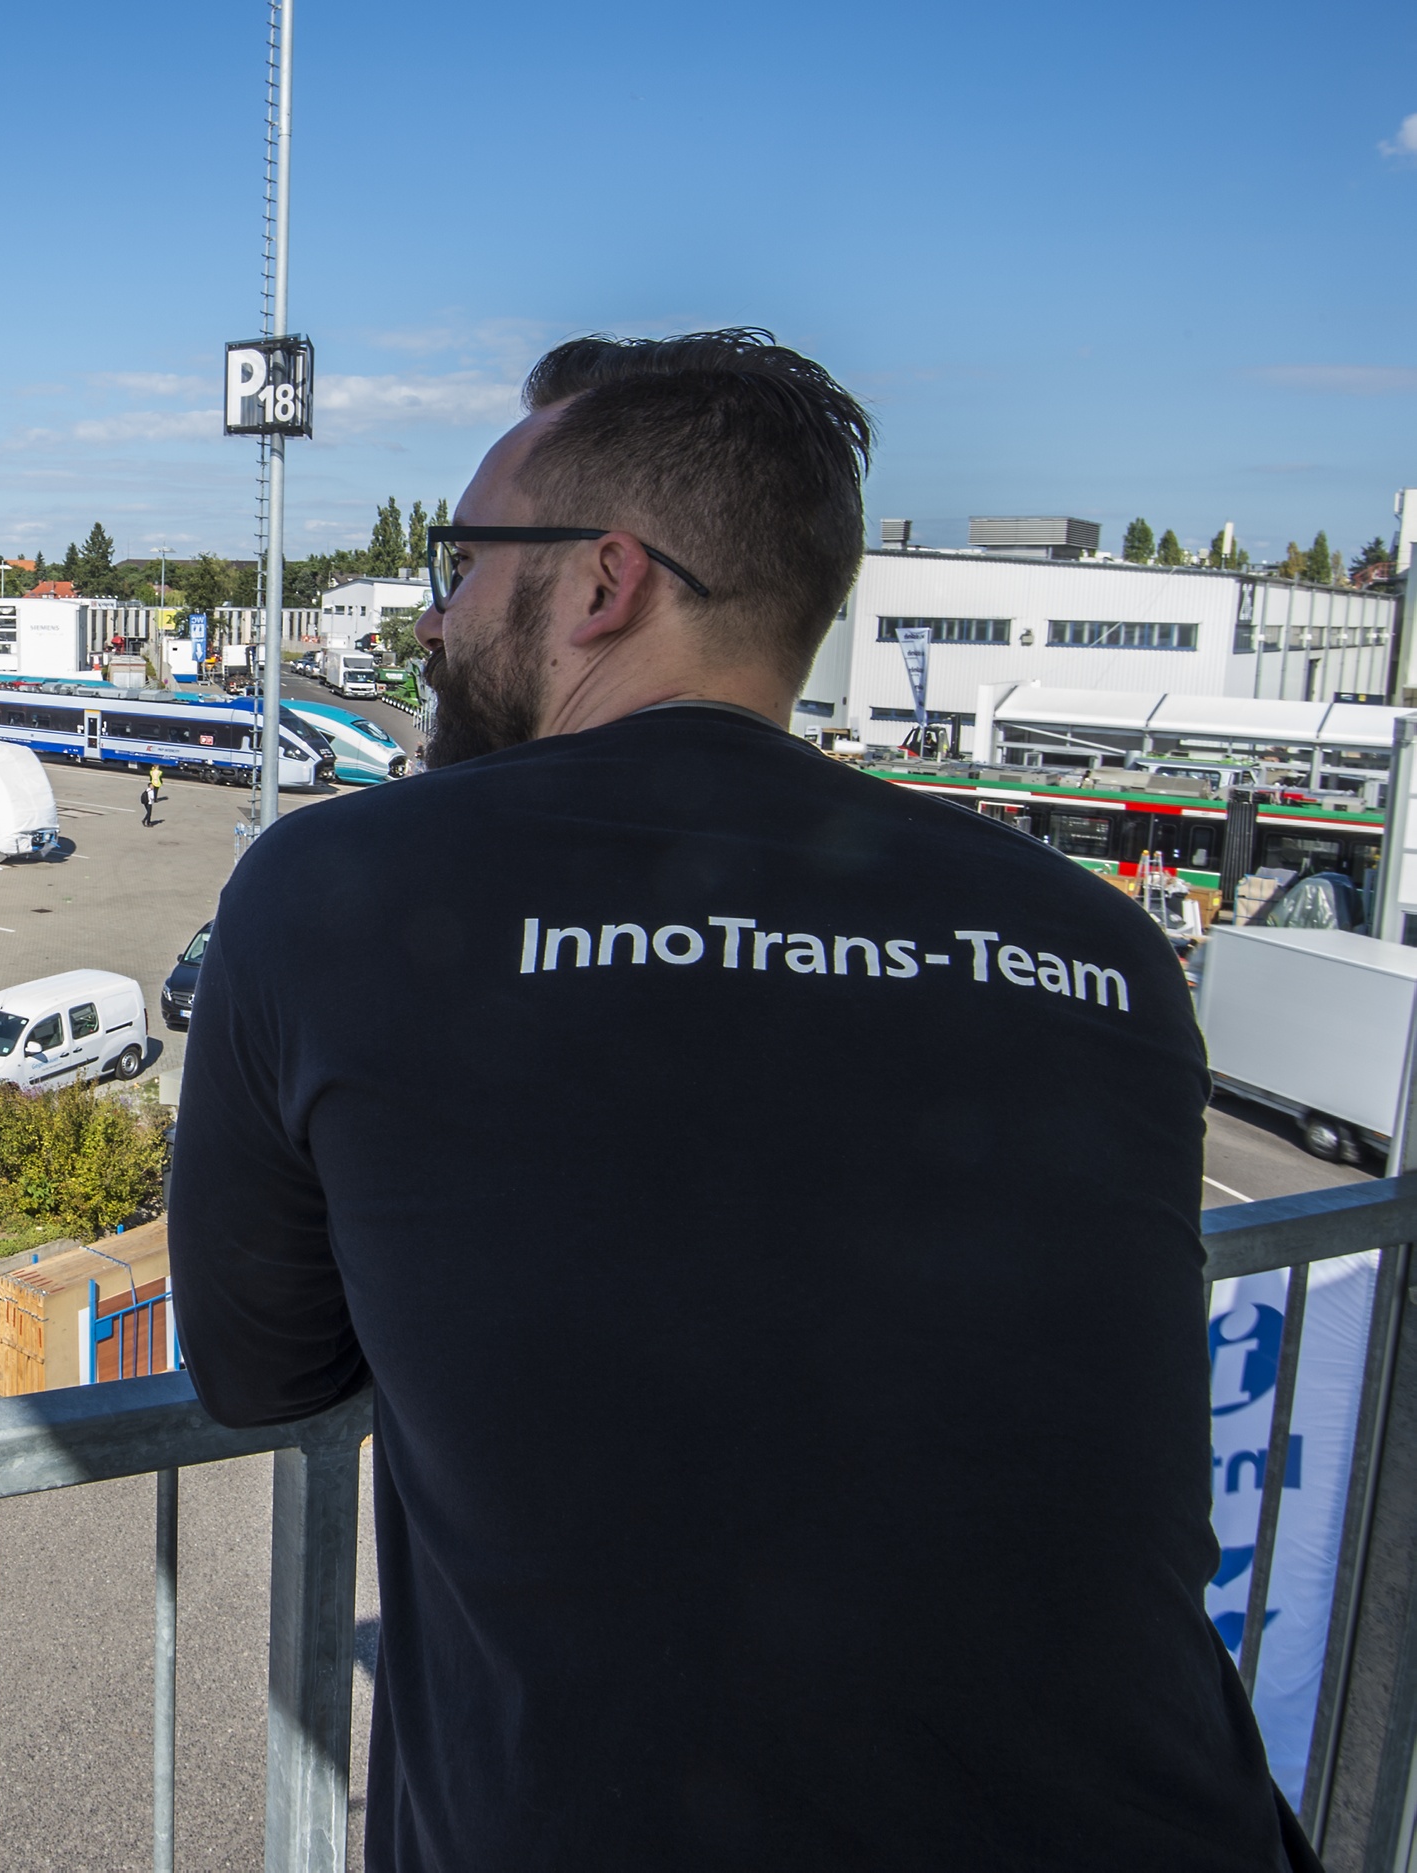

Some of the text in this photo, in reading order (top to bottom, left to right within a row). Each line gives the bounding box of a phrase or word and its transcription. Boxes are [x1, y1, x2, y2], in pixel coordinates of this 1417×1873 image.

[227, 348, 296, 426] P 18
[520, 915, 1129, 1012] InnoTrans-Team
